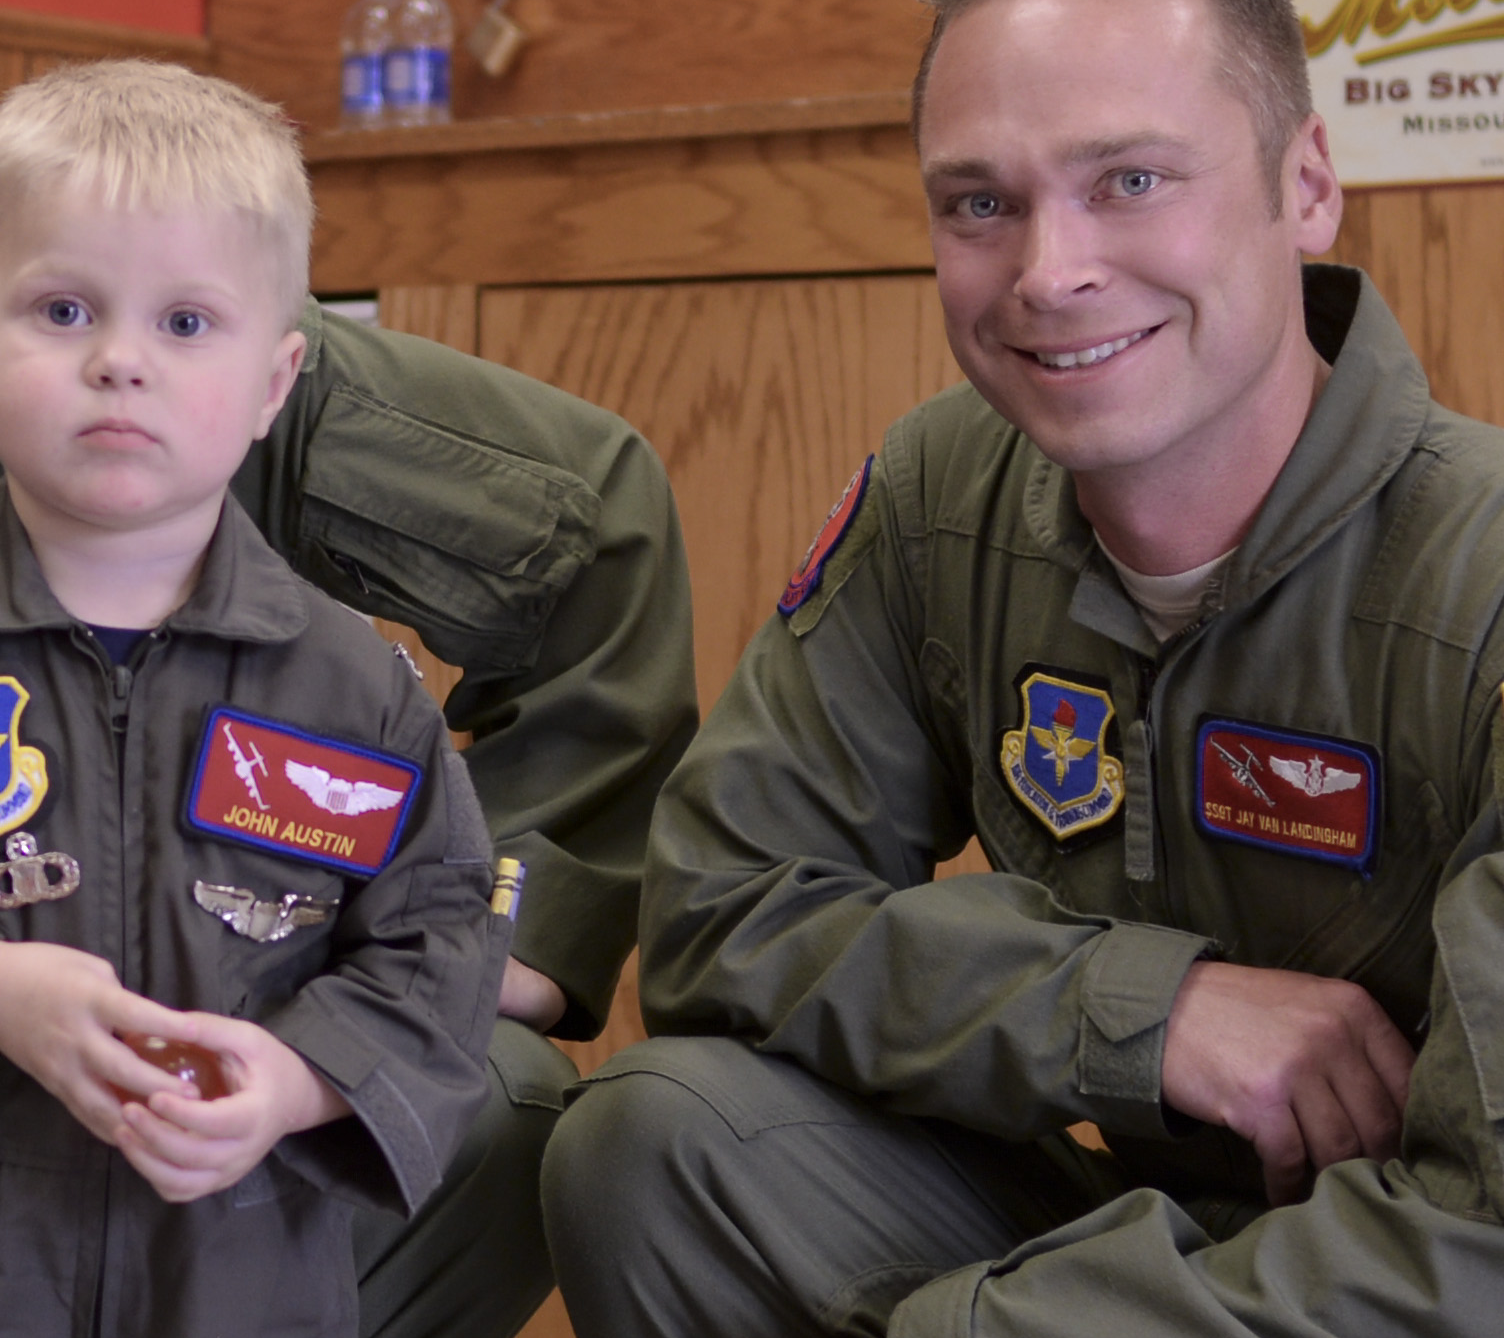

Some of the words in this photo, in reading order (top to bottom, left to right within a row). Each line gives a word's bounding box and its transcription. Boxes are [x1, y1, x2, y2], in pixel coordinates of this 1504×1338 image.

[223, 804, 279, 838] JOHN
[280, 821, 357, 858] AUSTIN
[1205, 801, 1232, 822] SSGT
[1236, 810, 1255, 828] JAY
[1258, 814, 1280, 835] VAN
[1282, 821, 1357, 849] LANDINGHAM
